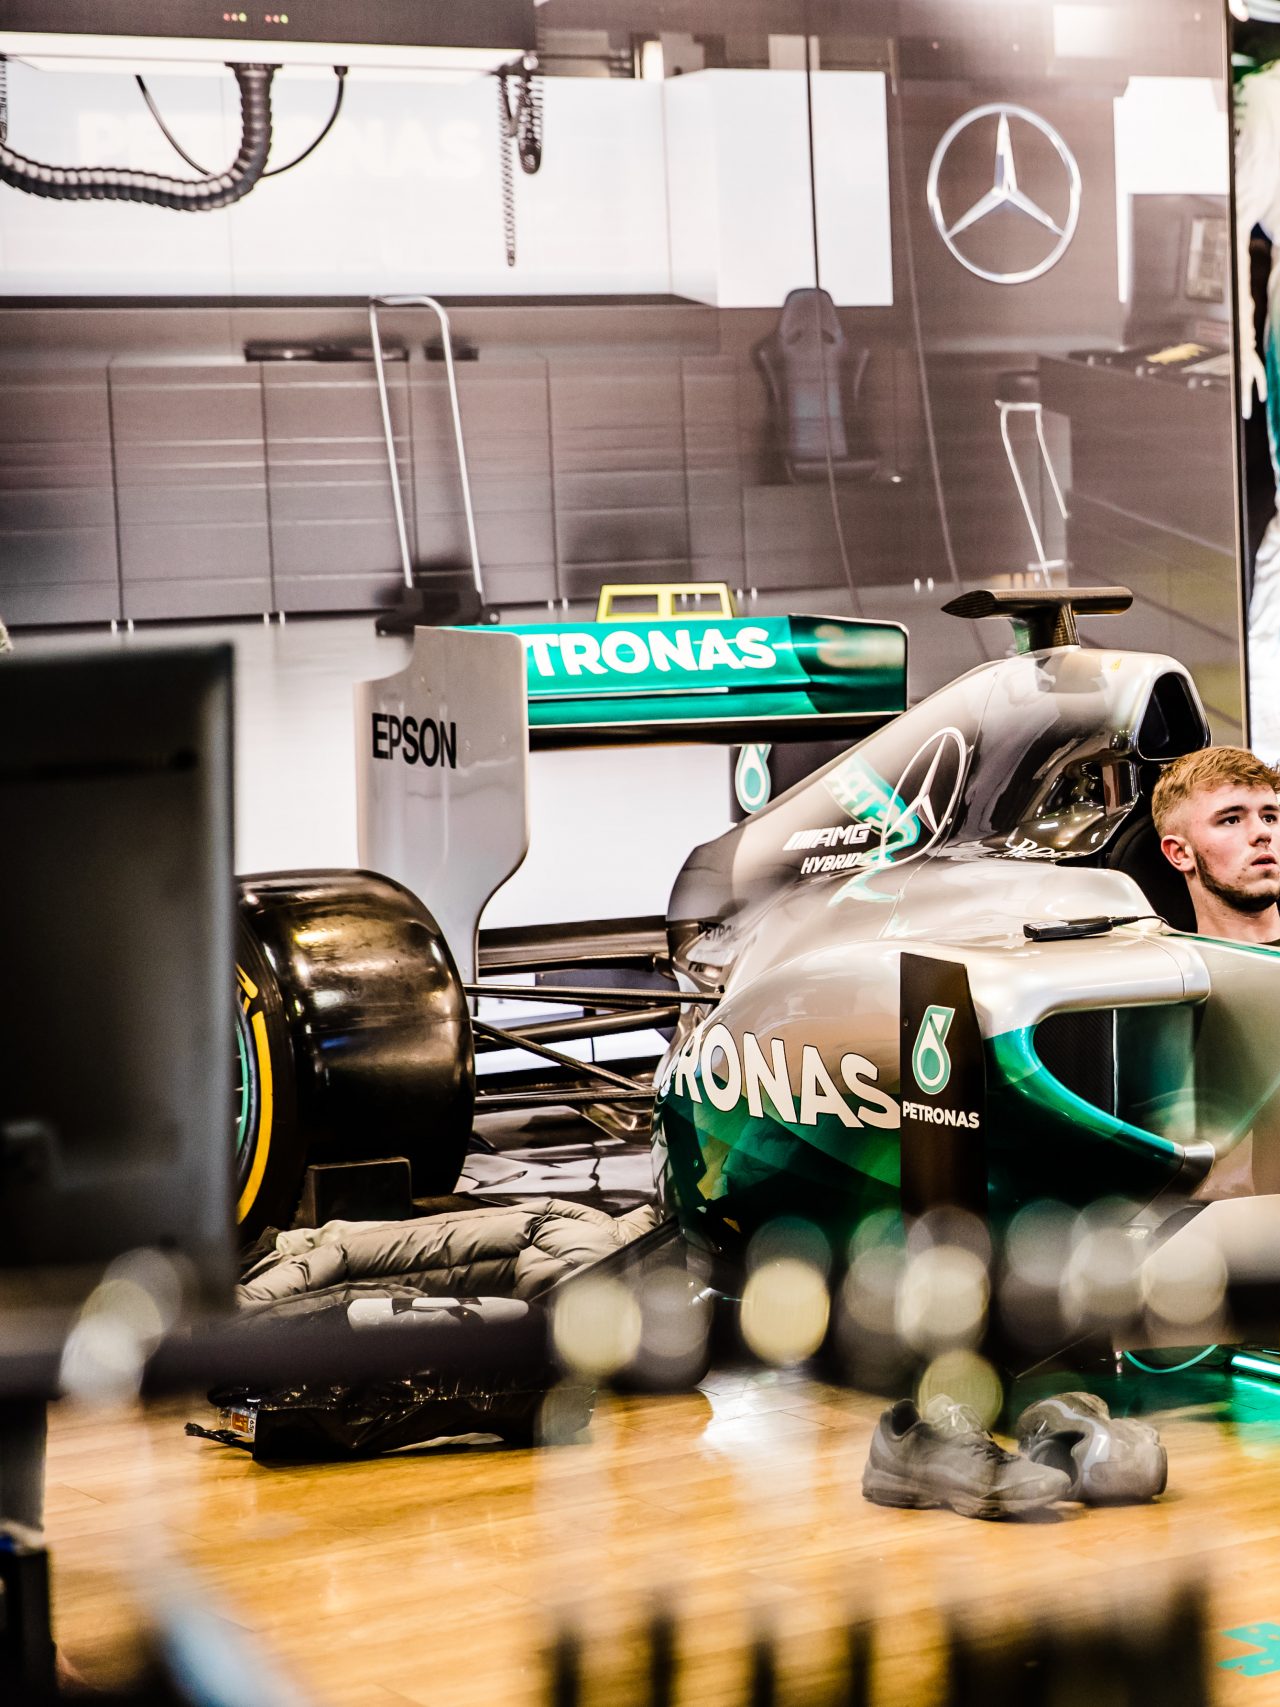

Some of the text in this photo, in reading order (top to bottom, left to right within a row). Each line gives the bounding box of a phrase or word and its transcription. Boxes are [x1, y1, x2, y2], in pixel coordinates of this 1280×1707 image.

[372, 712, 457, 770] EPSON
[812, 822, 873, 849] AMG
[800, 851, 863, 876] HYBRID
[662, 1022, 901, 1130] RONAS
[902, 1100, 981, 1129] PETRONAS
